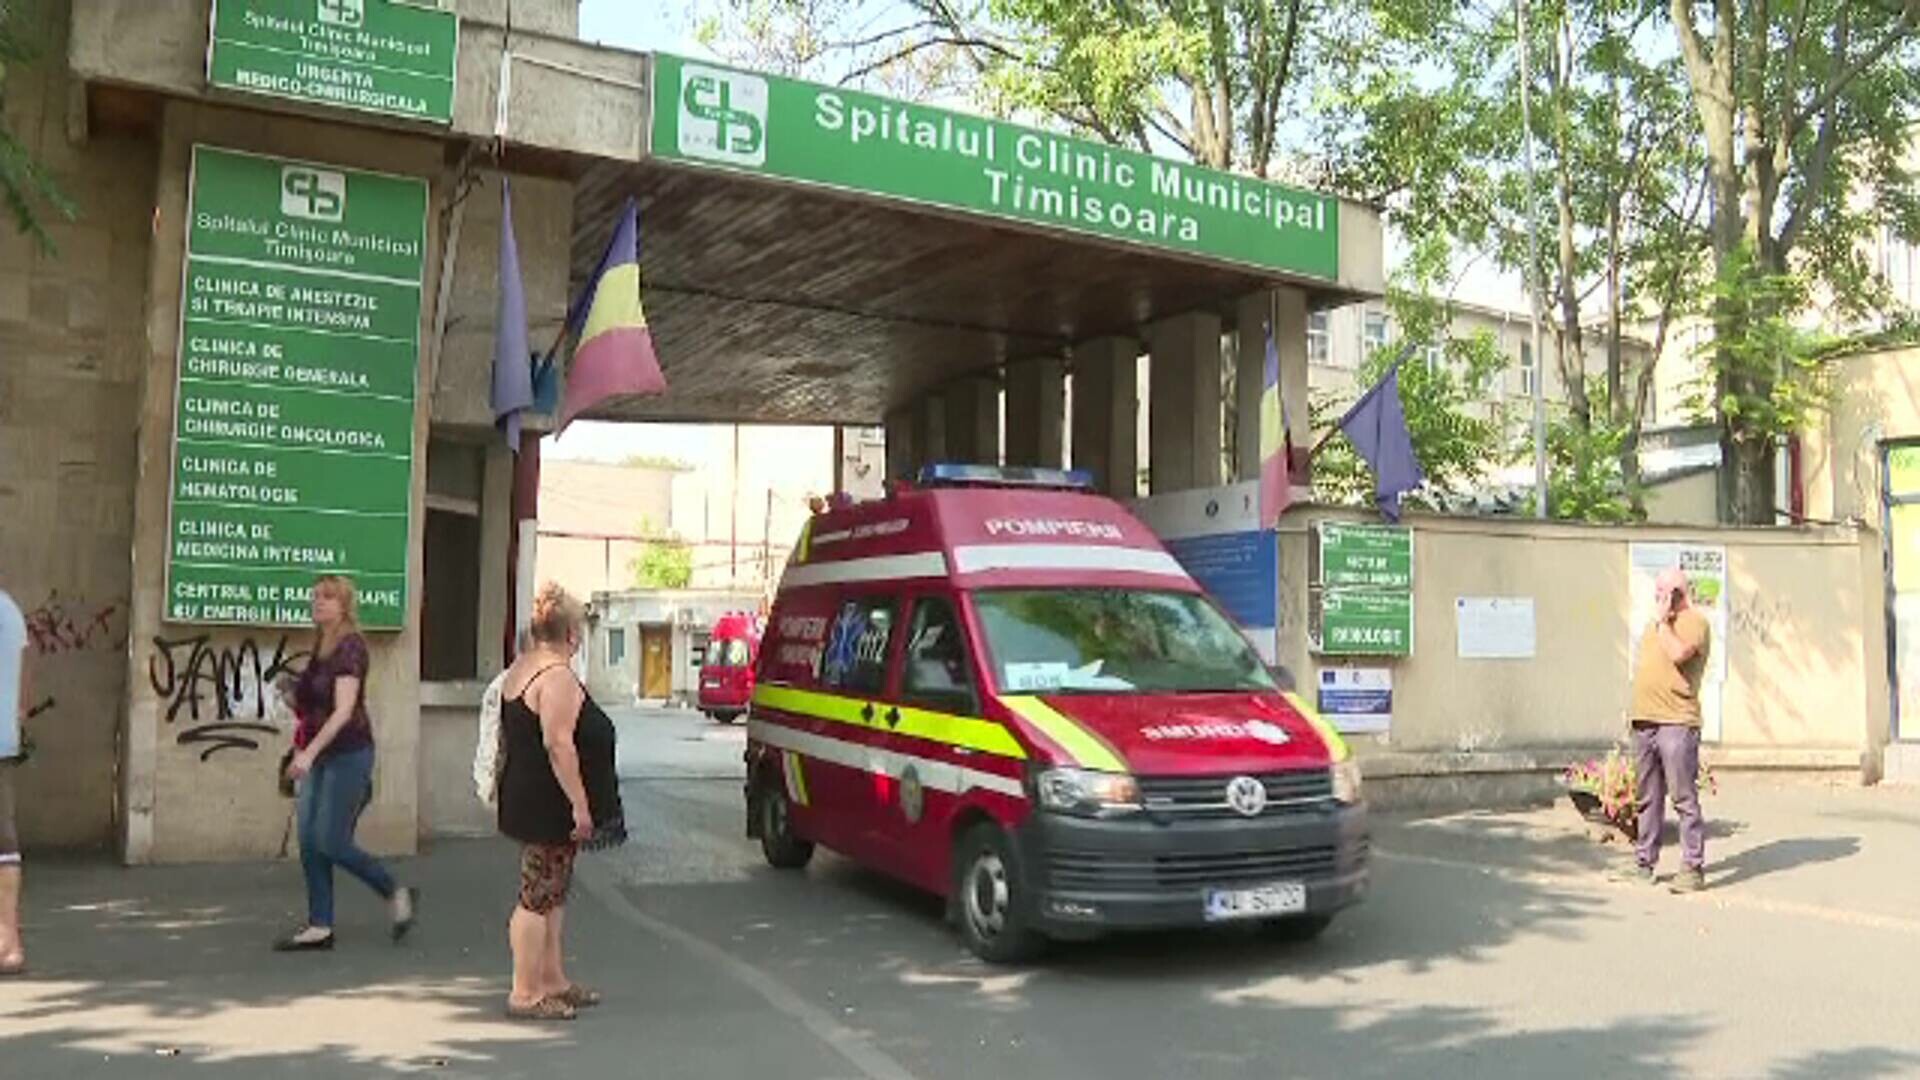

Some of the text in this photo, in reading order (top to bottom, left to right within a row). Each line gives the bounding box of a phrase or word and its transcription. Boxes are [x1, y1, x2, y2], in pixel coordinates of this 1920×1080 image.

[814, 92, 1326, 232] Spitalul Clinic Municipal
[982, 168, 1199, 242] Timisoara
[275, 222, 327, 244] Clinic
[332, 230, 418, 257] Municipal
[194, 276, 378, 310] CLINICA DE ANESTEZIE
[214, 298, 283, 319] TERAPIE
[190, 337, 283, 359] CLINICA DE
[188, 358, 369, 388] CHIRURGIE GENERALA
[185, 397, 280, 418] CLINICA DE
[185, 419, 385, 448] CHIRURGIE ONCOLOGICA
[182, 457, 277, 478] CLINICA DE
[179, 520, 272, 540] CLINICA DE
[176, 541, 259, 560] MEDICINA
[264, 547, 334, 564] INTERNA
[174, 581, 251, 600] CENTRUL
[257, 586, 280, 601] DE
